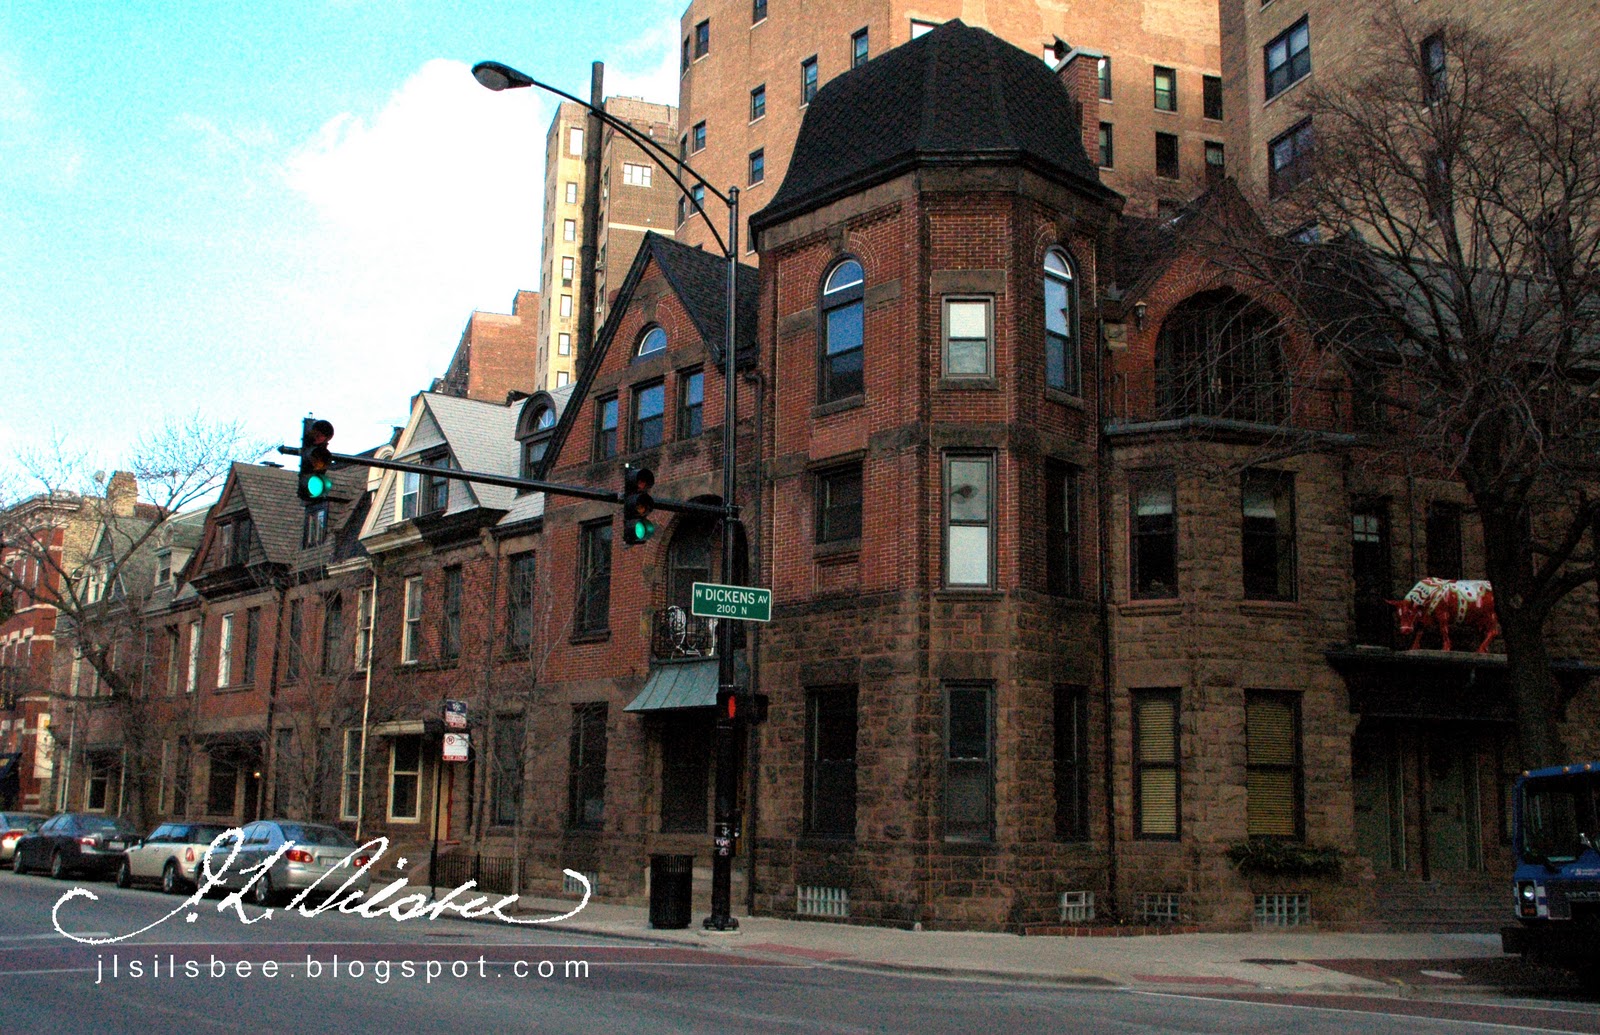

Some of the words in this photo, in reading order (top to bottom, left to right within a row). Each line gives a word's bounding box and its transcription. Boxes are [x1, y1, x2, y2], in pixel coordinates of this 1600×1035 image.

[695, 589, 702, 598] W
[705, 588, 755, 604] DICKENS
[757, 595, 768, 604] AV
[716, 604, 736, 614] 2100
[741, 606, 747, 615] N
